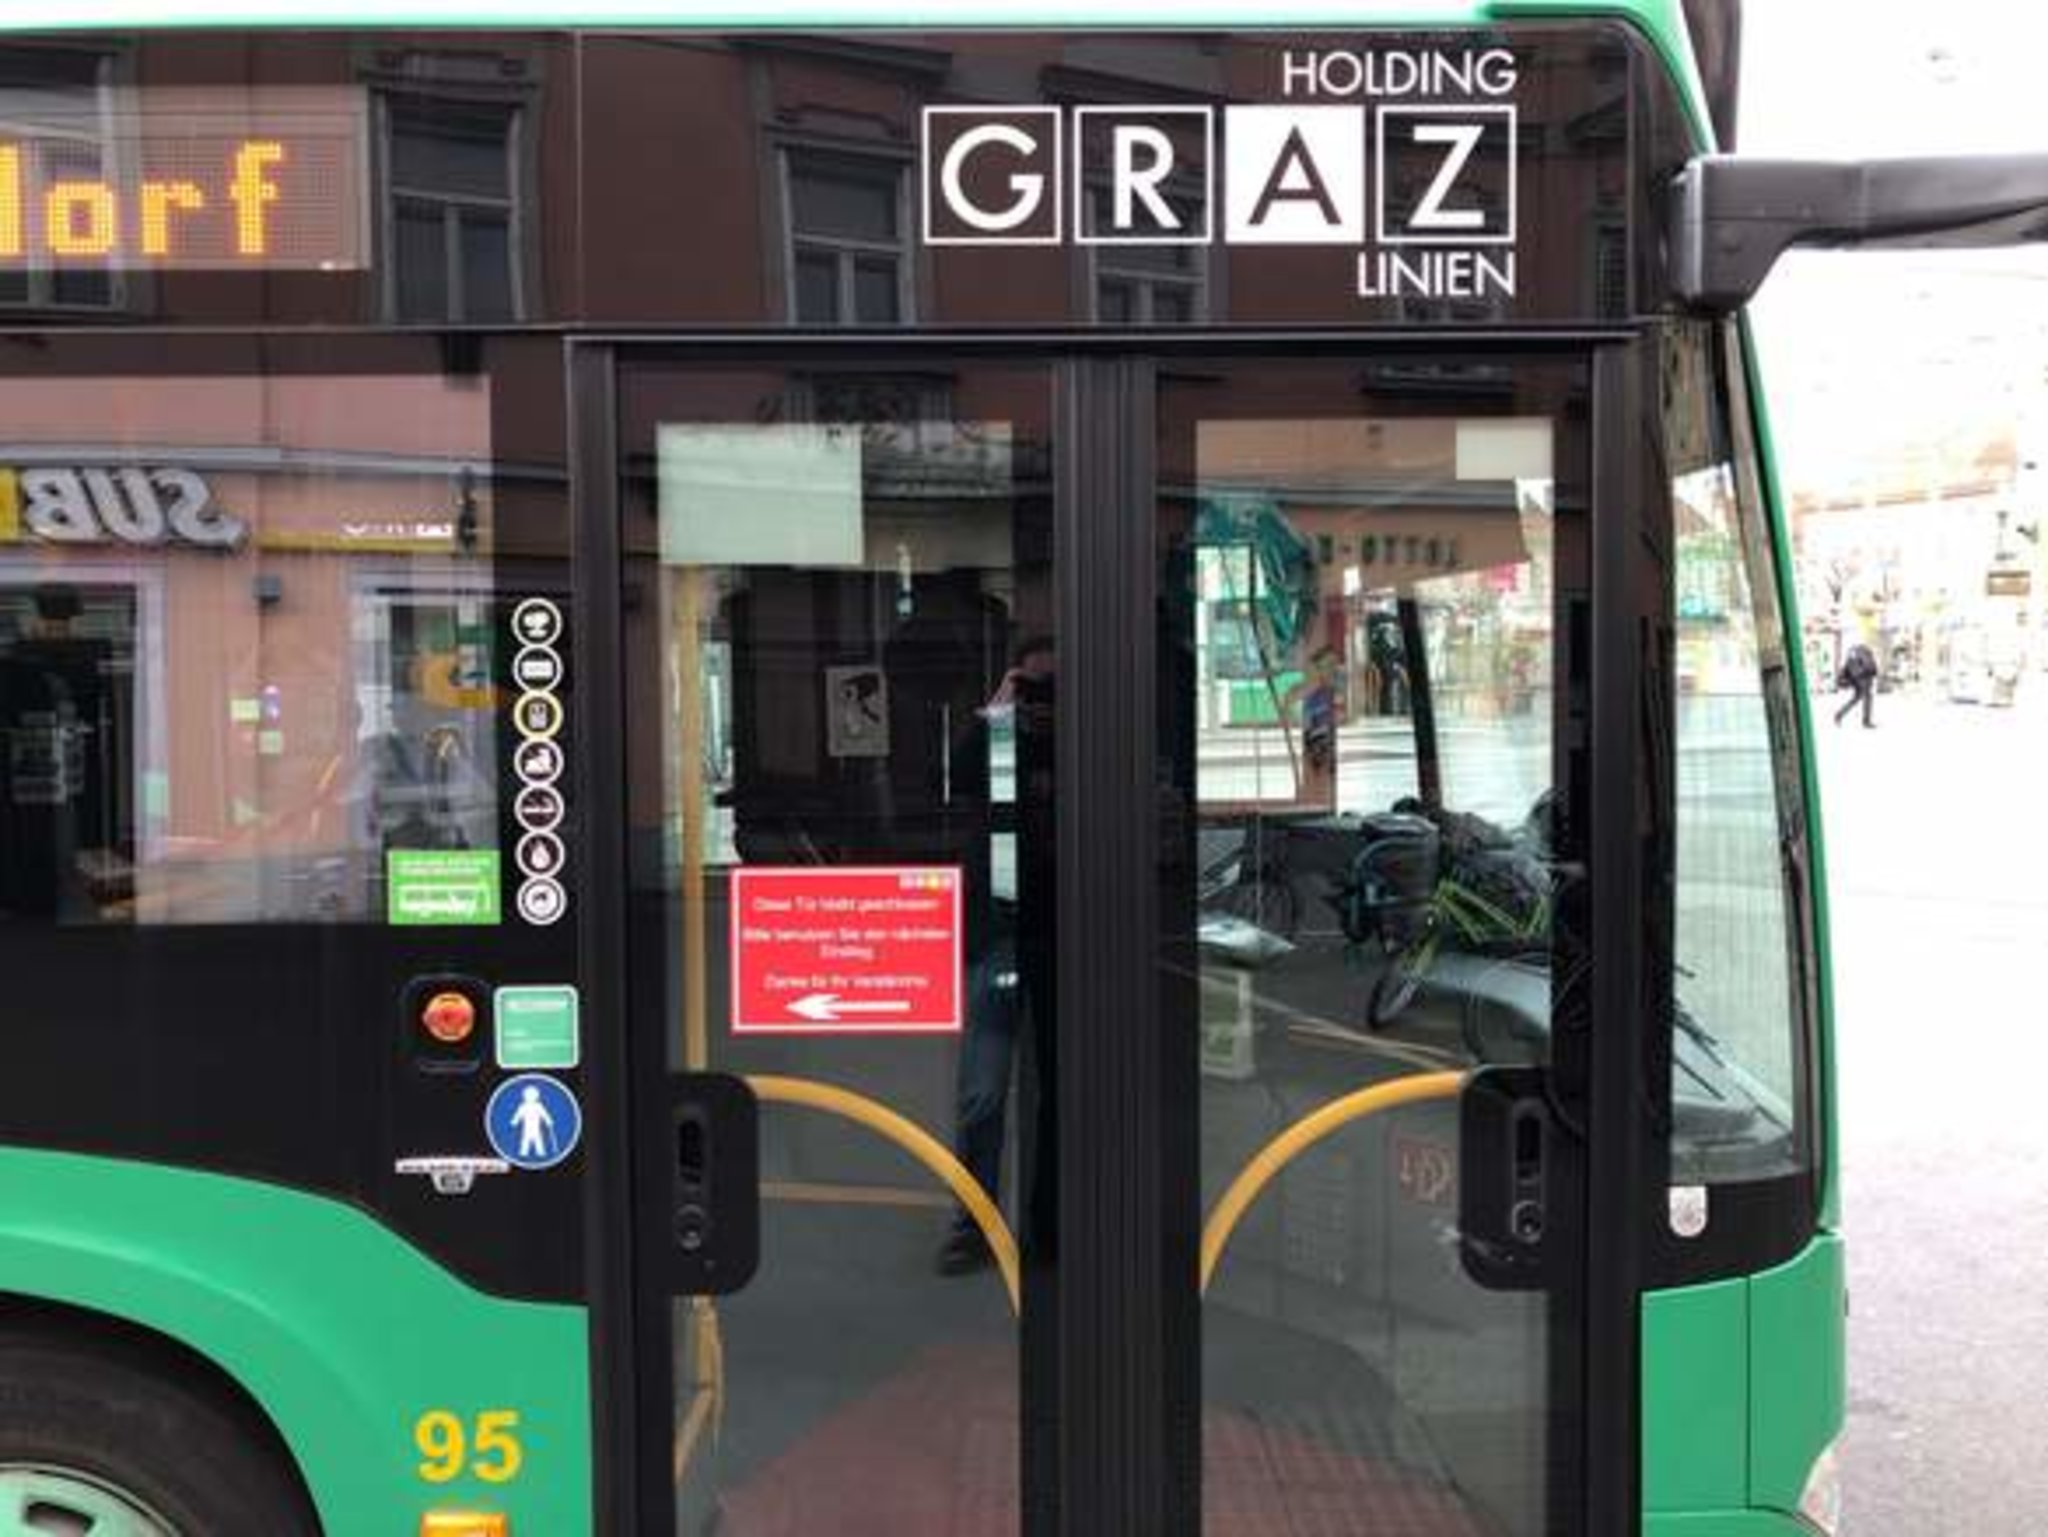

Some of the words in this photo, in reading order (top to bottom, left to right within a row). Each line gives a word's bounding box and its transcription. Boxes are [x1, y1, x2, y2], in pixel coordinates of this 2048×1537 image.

[1283, 49, 1518, 97] HOLDING
[939, 121, 1488, 231] GRAZ
[1357, 250, 1517, 298] LINIEN
[414, 1409, 523, 1483] 95
